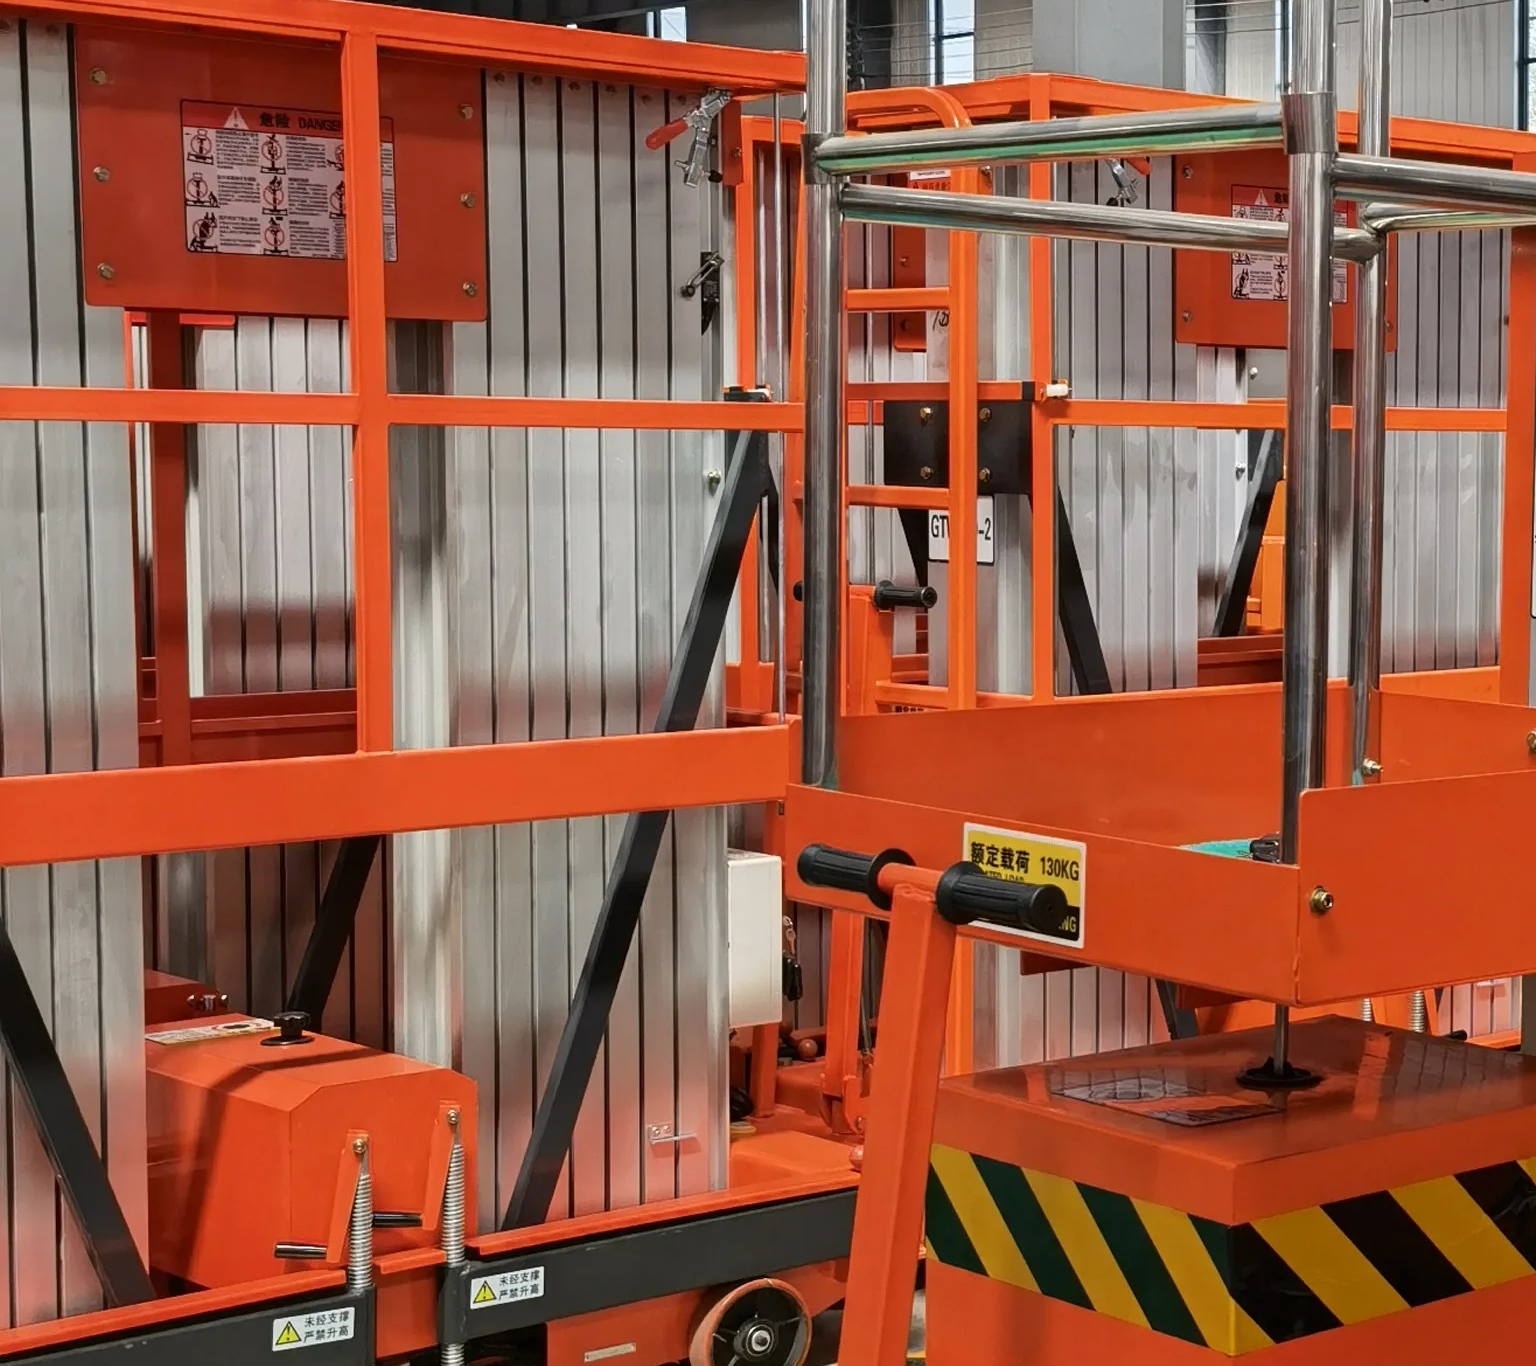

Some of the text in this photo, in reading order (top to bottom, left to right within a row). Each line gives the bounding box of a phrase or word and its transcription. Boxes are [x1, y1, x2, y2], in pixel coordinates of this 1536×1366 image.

[298, 116, 343, 132] DANGE
[971, 841, 1080, 881] 额定载荷 130KG
[499, 1269, 541, 1287] 未经支撑
[498, 1283, 540, 1301] 严禁升高
[304, 1310, 350, 1328] 未经支撑
[303, 1325, 350, 1344] 严禁升高
